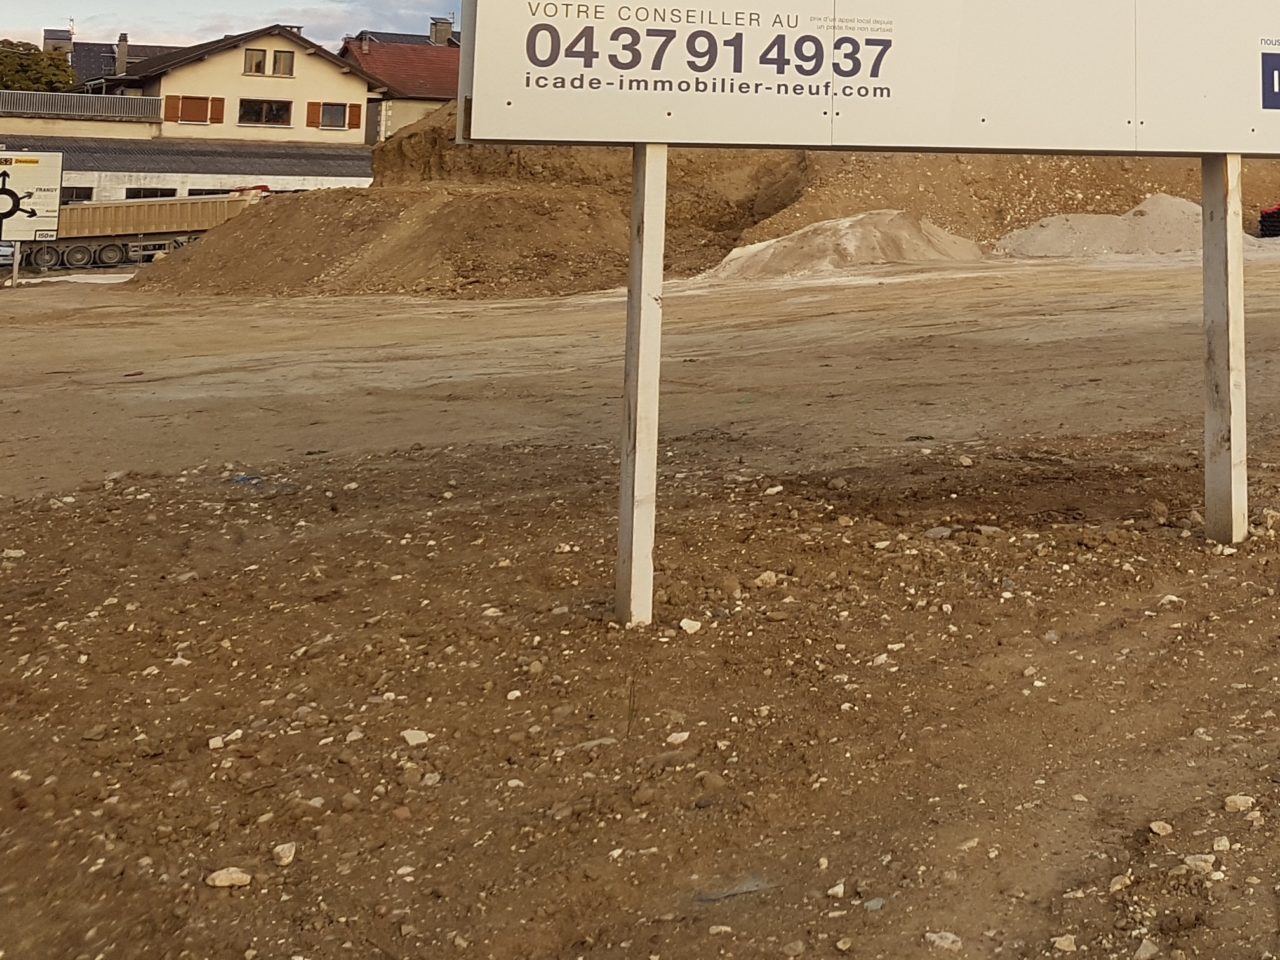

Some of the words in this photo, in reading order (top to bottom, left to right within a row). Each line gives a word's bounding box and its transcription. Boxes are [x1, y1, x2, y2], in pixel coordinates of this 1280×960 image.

[528, 1, 605, 20] VOTRE
[618, 6, 760, 27] CONSEILLER
[772, 14, 799, 29] AU
[1260, 38, 1280, 47] nous
[525, 71, 891, 98] icade-immobilier-neuf.com
